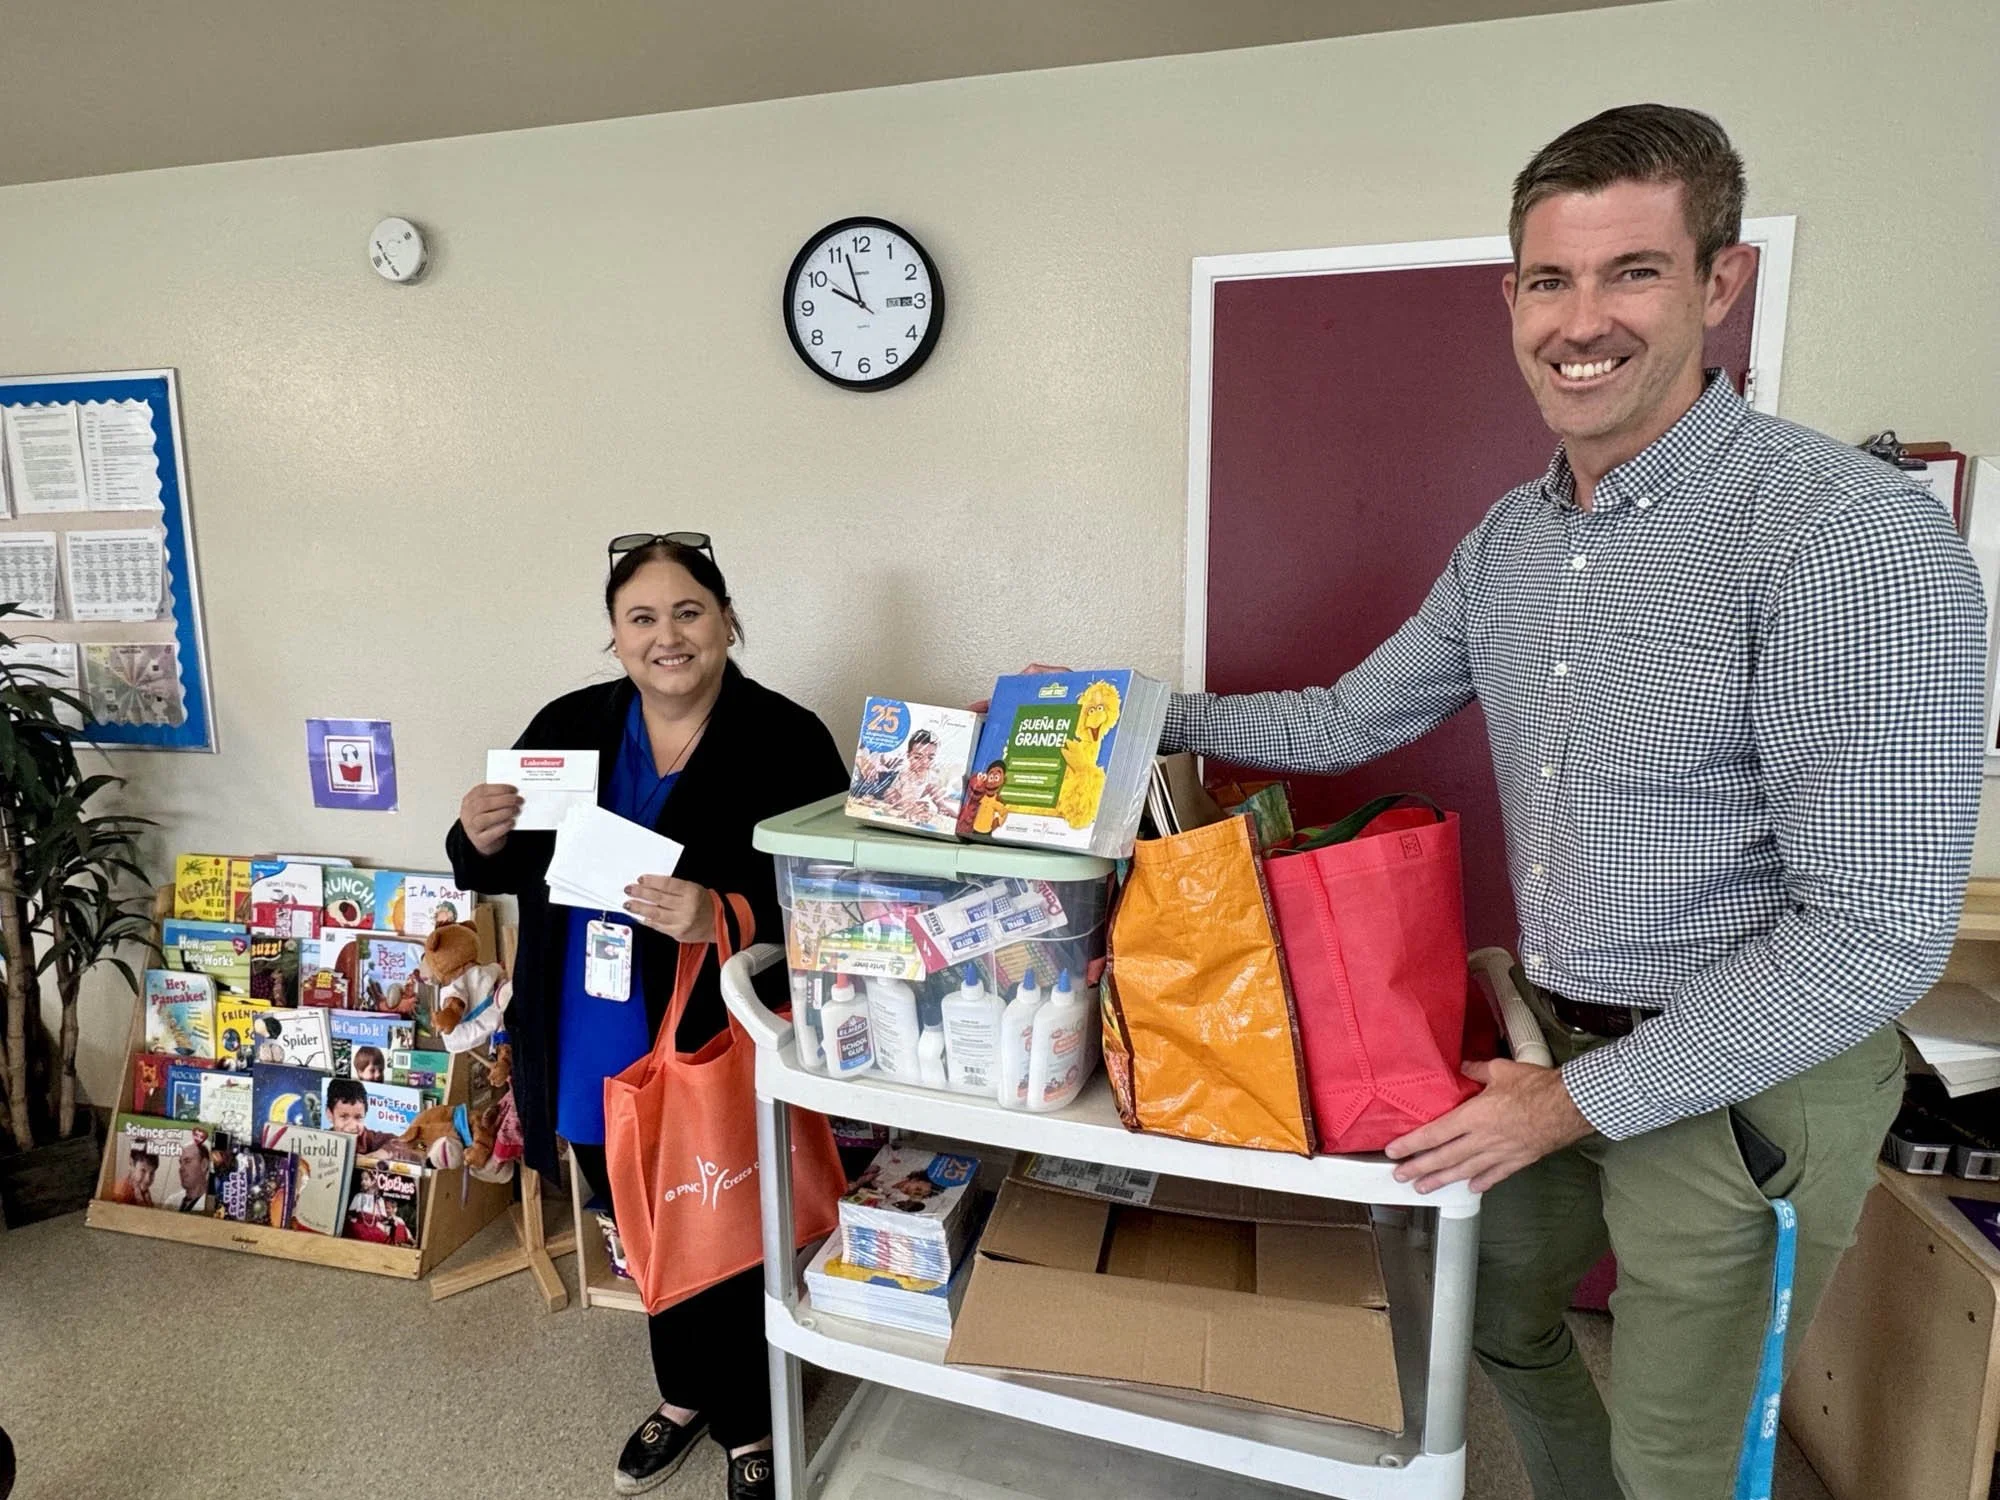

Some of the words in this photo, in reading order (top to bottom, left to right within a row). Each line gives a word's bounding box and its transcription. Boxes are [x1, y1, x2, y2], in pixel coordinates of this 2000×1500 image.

[852, 236, 870, 253] 12
[887, 243, 893, 260] 1
[828, 247, 842, 264] 11
[808, 271, 827, 288] 10
[905, 264, 917, 280] 2
[801, 300, 814, 316] 9
[913, 293, 926, 309] 3
[811, 329, 824, 345] 8
[905, 325, 918, 341] 4
[831, 351, 842, 367] 7
[885, 348, 898, 364] 5
[857, 357, 870, 373] 6
[867, 704, 901, 734] 25
[1018, 716, 1055, 732] ¡SUEÑA
[1056, 719, 1071, 731] EN
[1015, 732, 1067, 748] GRANDE!
[408, 886, 418, 898] I
[420, 884, 437, 898] Am
[178, 934, 200, 950] How
[203, 955, 234, 967] Works
[378, 950, 406, 968] Red
[382, 966, 406, 980] Hen
[165, 978, 190, 991] Hey,
[151, 990, 207, 1006] Pancakes!
[222, 1008, 263, 1024] FRIEN
[342, 1022, 359, 1036] Can
[282, 1034, 319, 1051] Spider
[841, 1037, 867, 1052] SCHOOL
[847, 1045, 864, 1057] GLUE
[369, 1097, 418, 1111] Nut-Free
[378, 1111, 406, 1123] Diets
[125, 1122, 164, 1139] Science
[146, 1141, 182, 1156] Health
[291, 1136, 338, 1158] Harold
[945, 1158, 971, 1181] 25
[377, 1173, 415, 1195] Clothes
[723, 1167, 752, 1190] Crezca
[229, 1173, 239, 1214] SOLAR
[237, 1170, 247, 1219] SYSTEM
[676, 1182, 701, 1196] PNC
